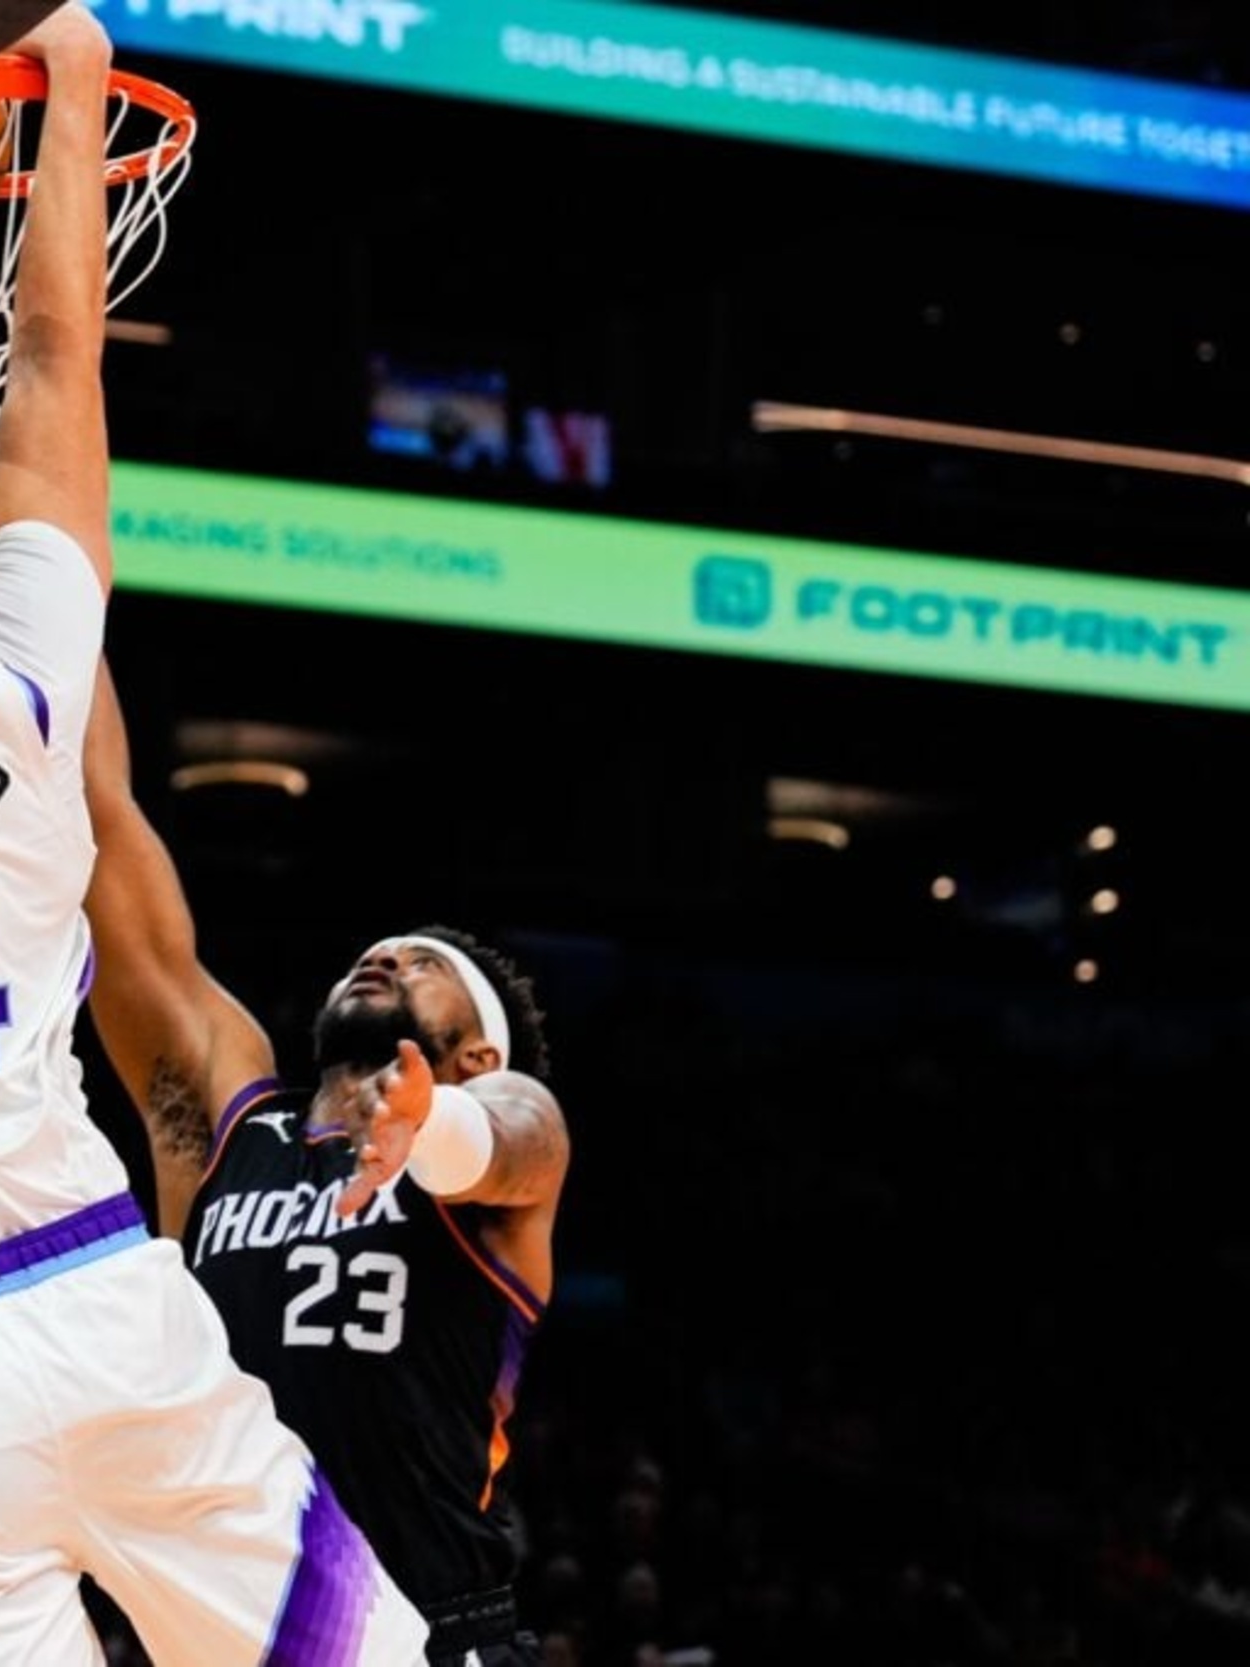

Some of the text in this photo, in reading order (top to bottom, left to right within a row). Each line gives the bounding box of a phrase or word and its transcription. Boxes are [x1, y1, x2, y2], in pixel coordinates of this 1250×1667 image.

[502, 25, 1250, 171] BUILDING A SUSTAINABLE FUTURE TOGET
[796, 578, 1229, 665] FOOTPRINT
[283, 1245, 407, 1354] 23
